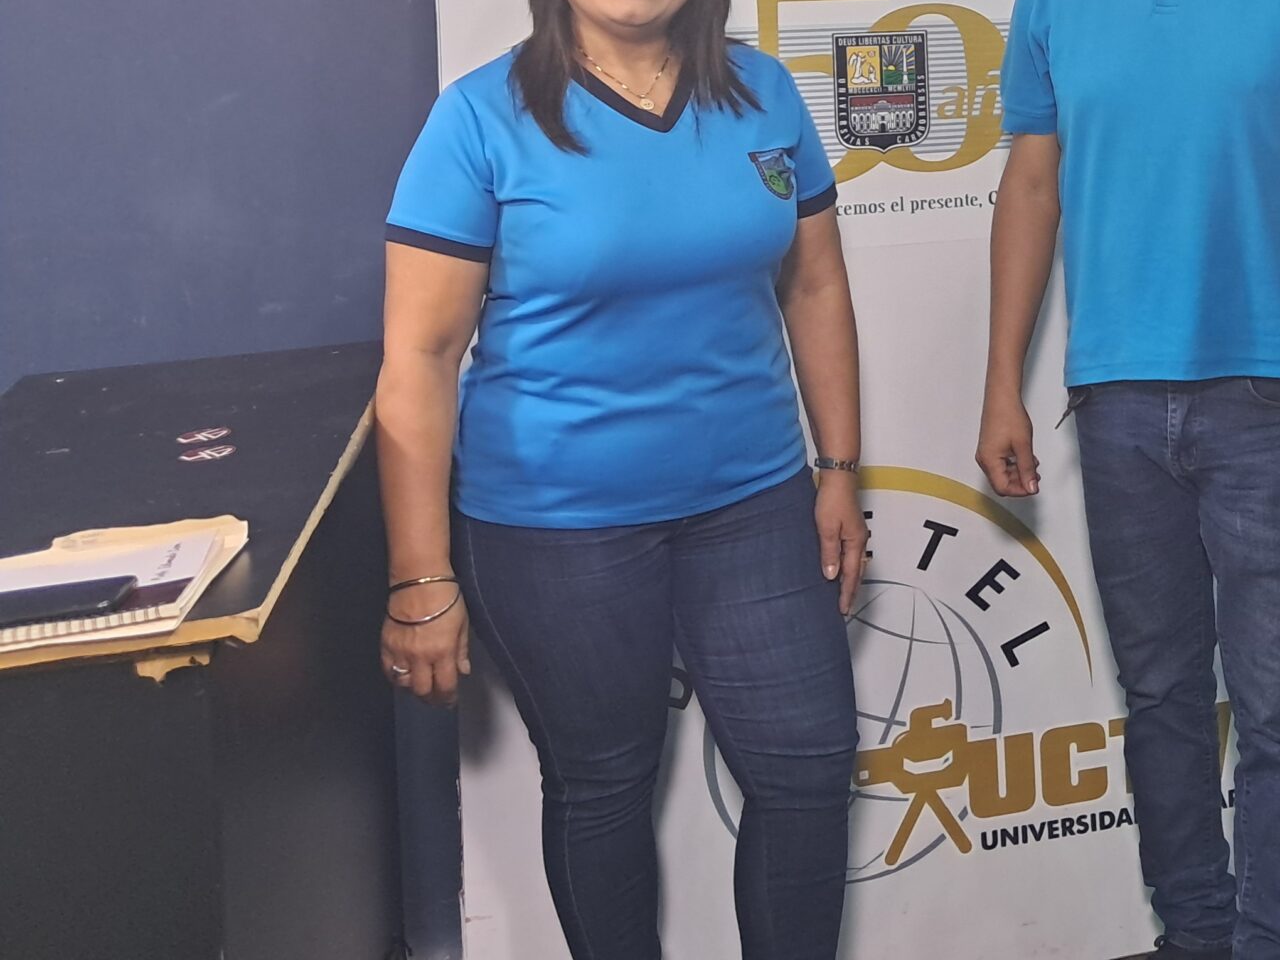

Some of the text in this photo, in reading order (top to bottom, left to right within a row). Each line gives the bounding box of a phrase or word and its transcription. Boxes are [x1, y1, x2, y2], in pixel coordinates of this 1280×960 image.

[838, 35, 923, 46] DEUS LIBERTAS CULTURA
[890, 196, 905, 212] el
[910, 193, 983, 215] presente,
[980, 807, 1139, 851] UNIVERSIDA
